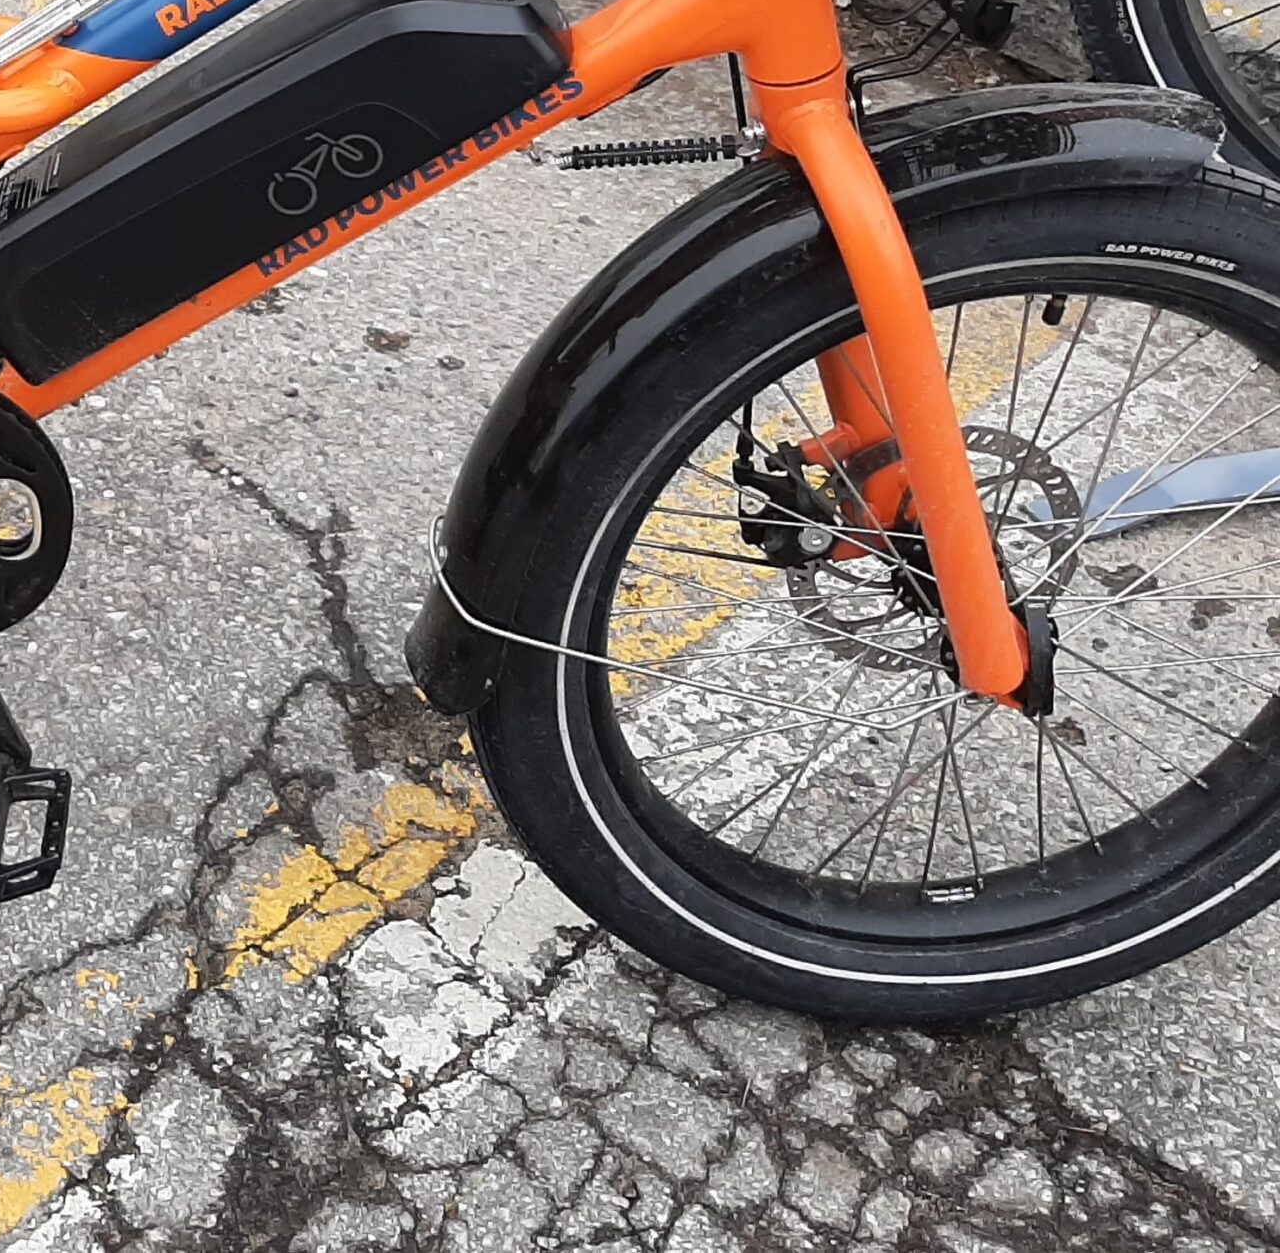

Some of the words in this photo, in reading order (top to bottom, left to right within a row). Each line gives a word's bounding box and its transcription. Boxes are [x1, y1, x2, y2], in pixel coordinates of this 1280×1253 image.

[256, 221, 329, 277] RAD
[334, 145, 469, 231] POWER
[472, 68, 583, 151] BIKES
[1105, 244, 1138, 253] RAD
[1140, 246, 1194, 261] POWER
[1195, 255, 1236, 271] BIKES
